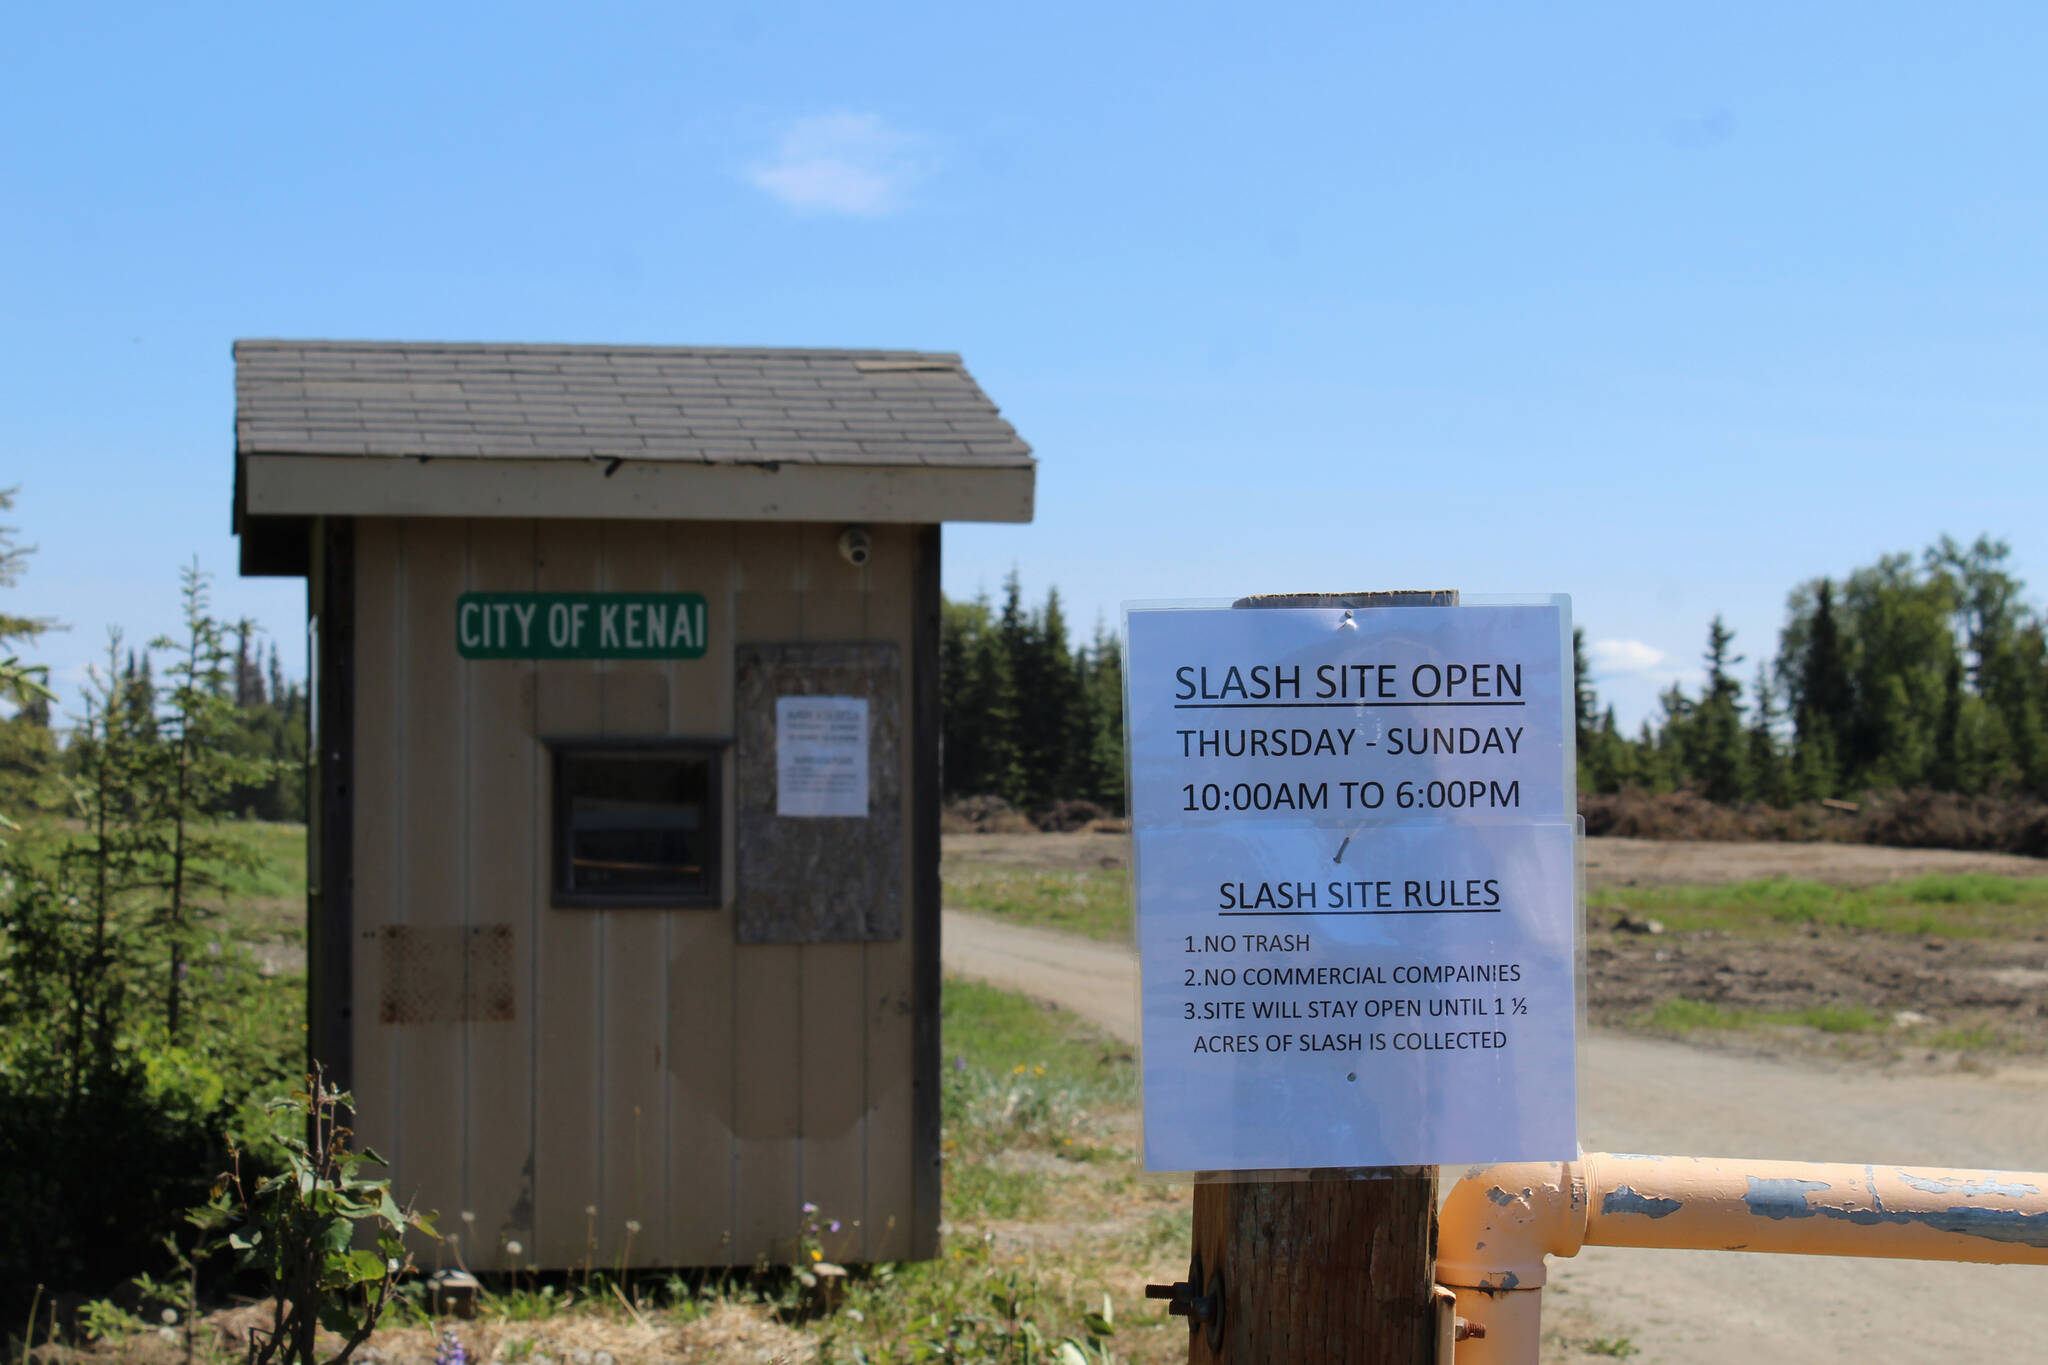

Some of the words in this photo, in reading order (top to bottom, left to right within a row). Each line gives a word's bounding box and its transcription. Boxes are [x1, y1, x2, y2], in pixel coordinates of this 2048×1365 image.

[460, 603, 537, 647] CITY
[548, 603, 589, 647] OF
[600, 604, 704, 647] KENAI
[1175, 666, 1300, 699] SLASH
[1315, 665, 1397, 698] SITE
[1411, 664, 1522, 697] OPEN
[1176, 729, 1356, 757] THURSDAY
[1386, 728, 1524, 755] SUNDAY
[1183, 783, 1328, 810] 10:00AM
[1339, 782, 1385, 808] TO
[1396, 781, 1520, 808] 6:00PM
[1219, 882, 1316, 909] SLASH
[1328, 882, 1392, 908] SITE
[1404, 880, 1500, 907] RULES
[1242, 935, 1310, 952] TRASH
[1243, 967, 1387, 985] COMMERCIAL
[1392, 965, 1521, 983] COMPAINIES
[1252, 1002, 1303, 1018] WILL
[1307, 1001, 1359, 1018] STAY
[1364, 1000, 1421, 1017] OPEN
[1429, 999, 1488, 1016] UNTIL
[1494, 999, 1505, 1014] 1
[1193, 1035, 1259, 1052] ACRES
[1265, 1035, 1293, 1051] OF
[1299, 1034, 1362, 1051] SLASH
[1370, 1033, 1386, 1050] IS
[1392, 1032, 1507, 1050] COLLECTED
